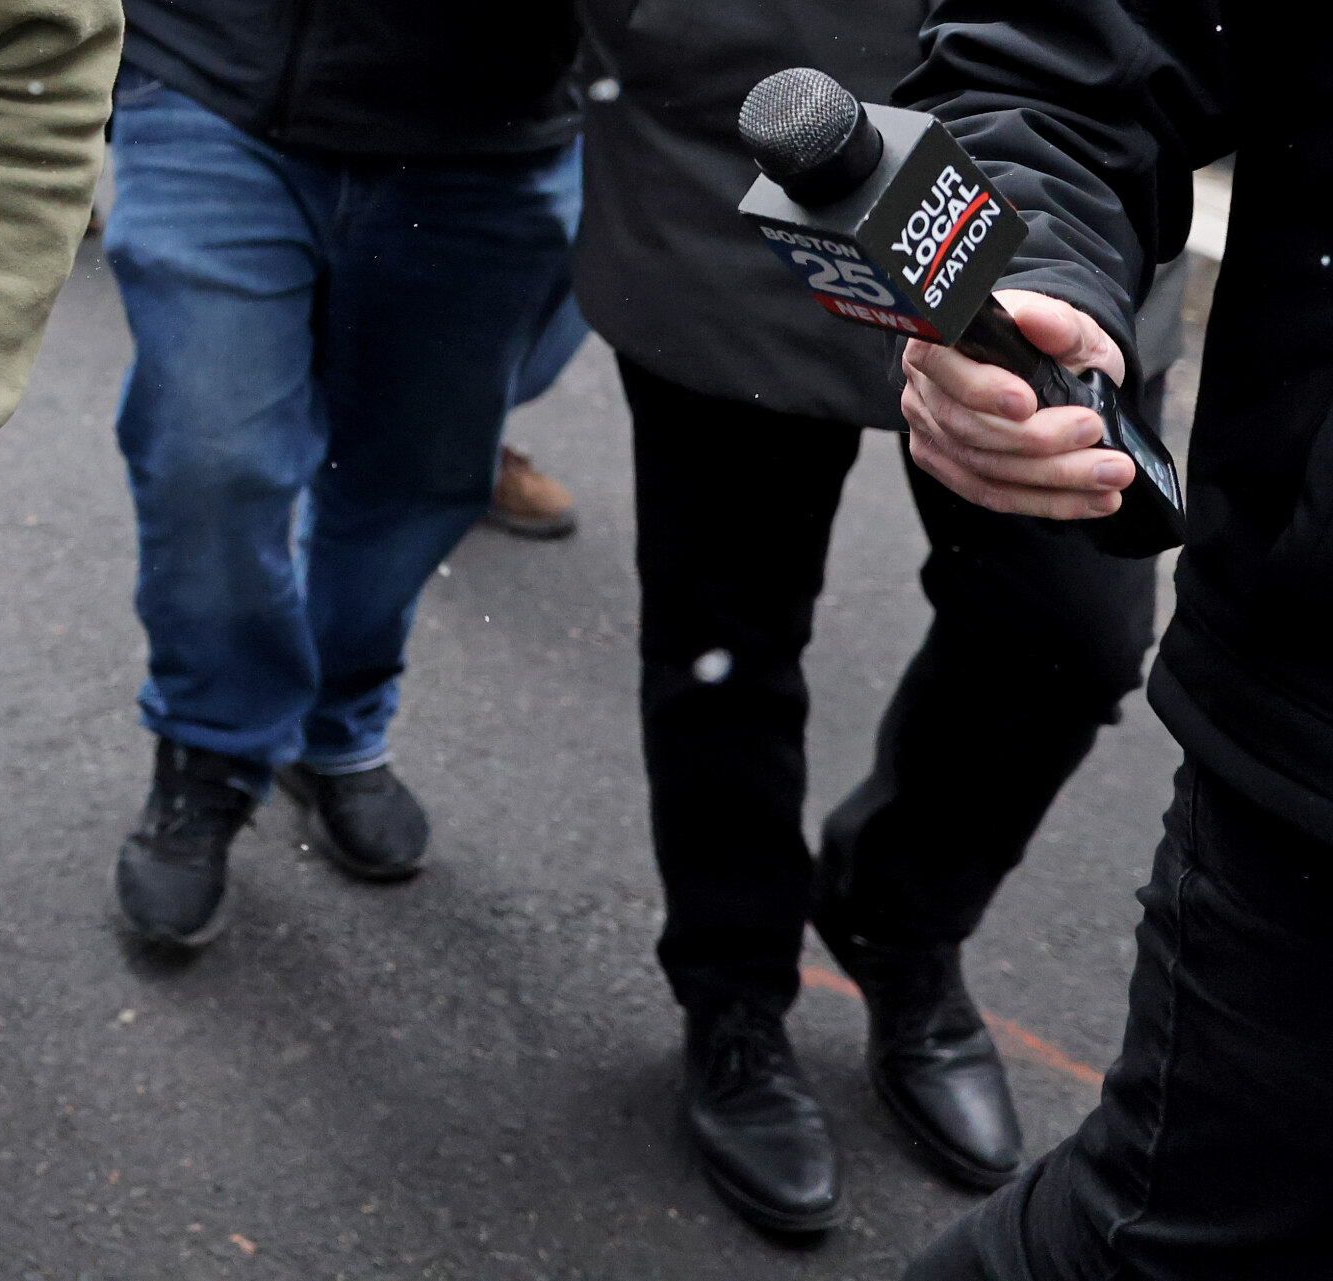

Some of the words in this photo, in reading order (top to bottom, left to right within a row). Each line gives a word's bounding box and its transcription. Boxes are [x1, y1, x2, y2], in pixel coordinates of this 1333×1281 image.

[759, 225, 861, 260] BOSTON
[891, 165, 962, 256] YOUR
[902, 184, 980, 285] LOCAL
[791, 250, 895, 307] 25
[924, 198, 1001, 309] STATION
[835, 300, 918, 332] NEWS
